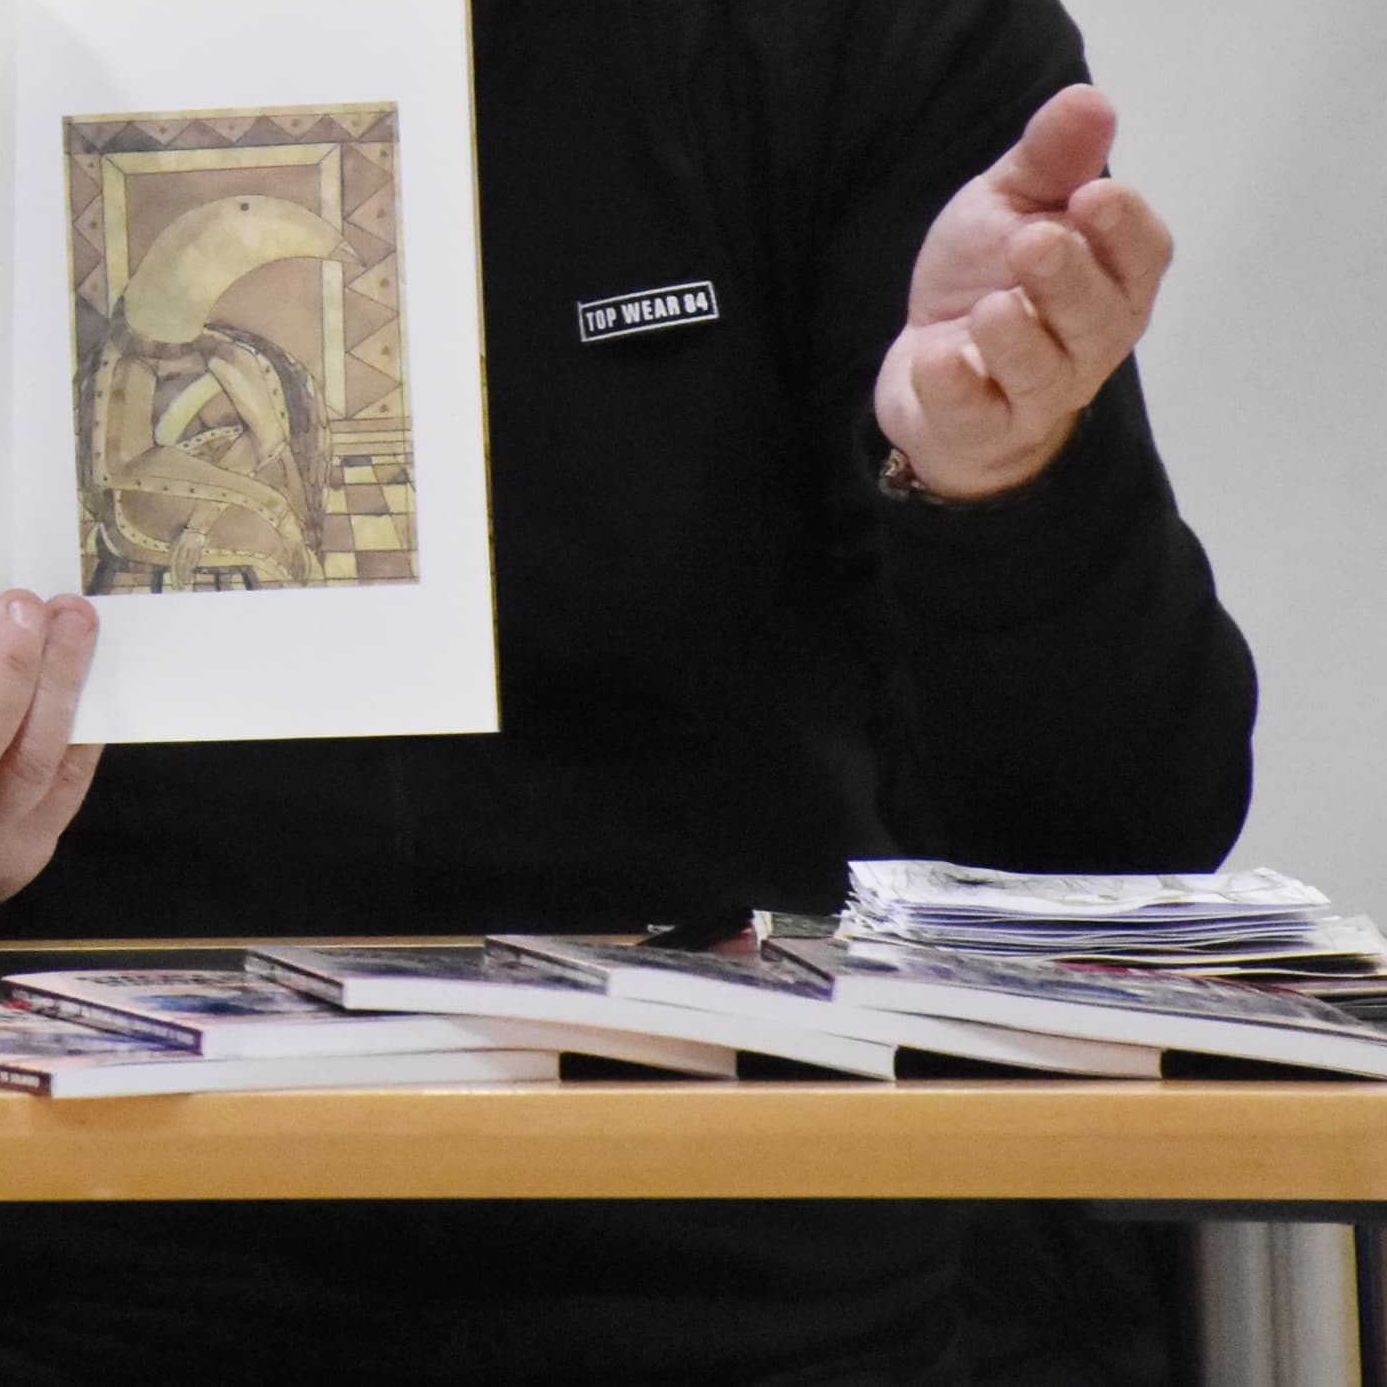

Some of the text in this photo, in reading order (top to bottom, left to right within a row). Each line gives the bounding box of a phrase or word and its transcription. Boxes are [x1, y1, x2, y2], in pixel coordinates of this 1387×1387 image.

[586, 291, 709, 332] TOP WEAR 84
